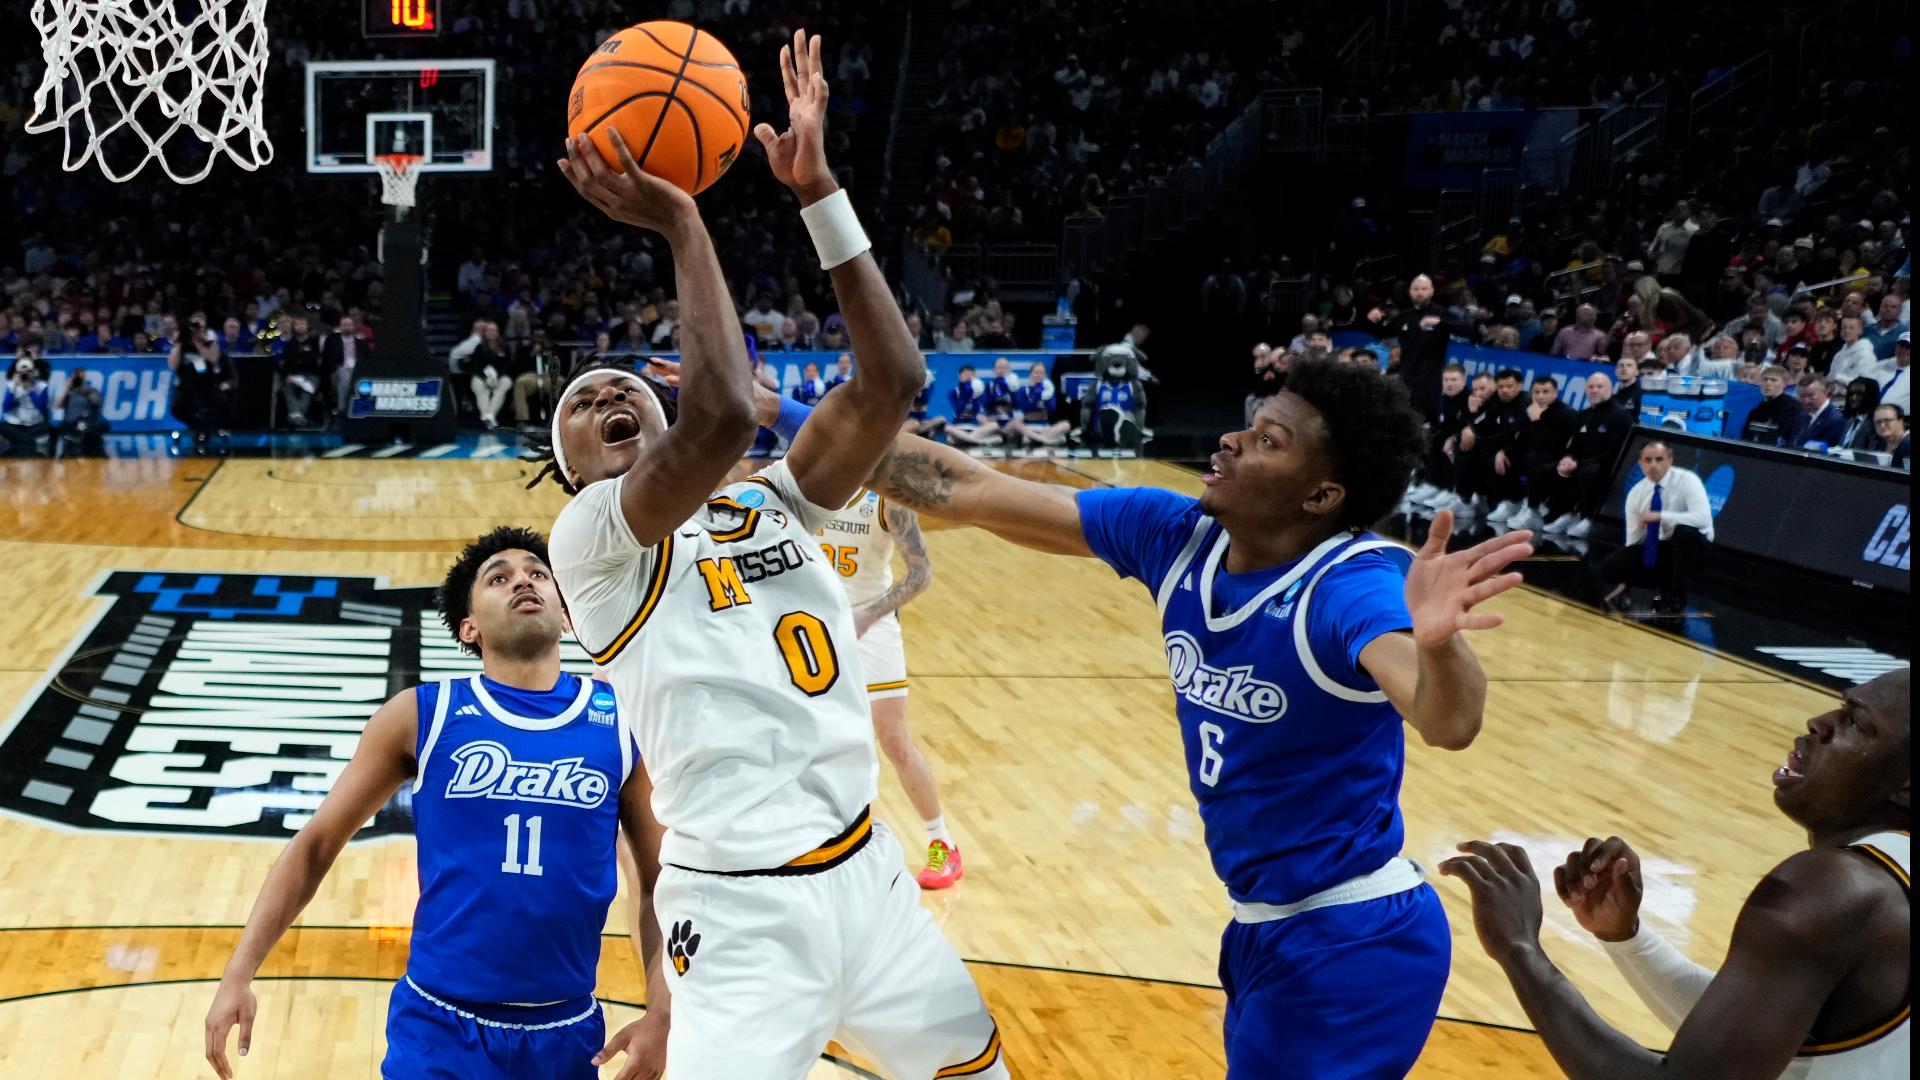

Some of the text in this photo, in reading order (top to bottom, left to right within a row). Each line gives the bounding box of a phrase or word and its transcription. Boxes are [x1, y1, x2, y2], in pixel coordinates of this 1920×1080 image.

[0, 370, 172, 421] ACH
[371, 383, 417, 396] MARCH
[375, 396, 438, 411] MADNESS
[816, 519, 870, 536] SSOURI
[1863, 503, 1911, 571] CE
[773, 610, 839, 698] 0
[1165, 630, 1288, 724] Drake
[444, 740, 609, 810] Drake
[1199, 720, 1225, 788] 6
[501, 813, 544, 877] 11
